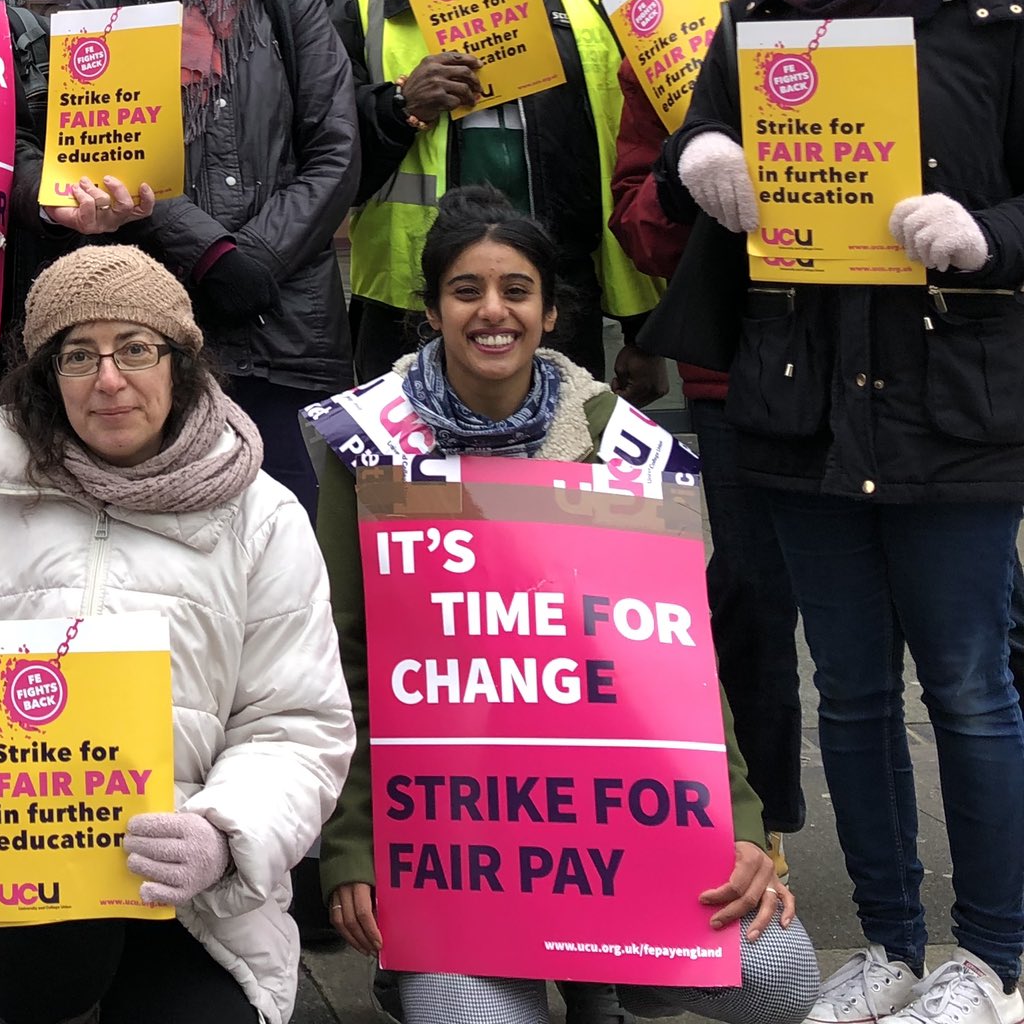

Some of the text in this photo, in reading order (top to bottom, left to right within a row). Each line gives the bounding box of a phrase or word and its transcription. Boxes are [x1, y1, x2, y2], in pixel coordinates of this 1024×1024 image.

[429, 3, 480, 27] Strike
[435, 18, 487, 46] FAIR
[489, 2, 529, 29] PAY
[84, 46, 94, 54] FE
[463, 29, 519, 54] further
[638, 32, 678, 66] Strike
[680, 16, 706, 35] for
[77, 51, 104, 64] FIGHTS
[479, 43, 527, 66] cation
[644, 46, 686, 85] FAIR
[688, 29, 716, 53] PA
[81, 60, 102, 71] BACK
[782, 64, 795, 73] FE
[652, 57, 703, 99] in furth
[773, 71, 810, 85] FIGHTS
[779, 82, 808, 94] BACK
[60, 88, 141, 106] Strike for
[59, 106, 162, 129] FAIR PAY
[756, 117, 865, 135] Strike for
[58, 129, 142, 146] in further
[57, 146, 145, 163] education
[757, 141, 896, 162] FAIR PAY
[759, 166, 869, 183] in further
[759, 187, 874, 205] education
[431, 592, 696, 647] TIME FOR
[27, 673, 42, 685] FE
[391, 658, 617, 705] CHANGE
[16, 682, 58, 699] FIGHTS
[23, 695, 56, 711] BACK
[79, 740, 120, 761] for
[84, 769, 153, 796] PAY
[385, 774, 715, 828] STRIKE FOR
[26, 802, 123, 823] further
[389, 842, 625, 897] FAIR PAY
[544, 940, 723, 960] www.ucu.org.uk/fepayengland
